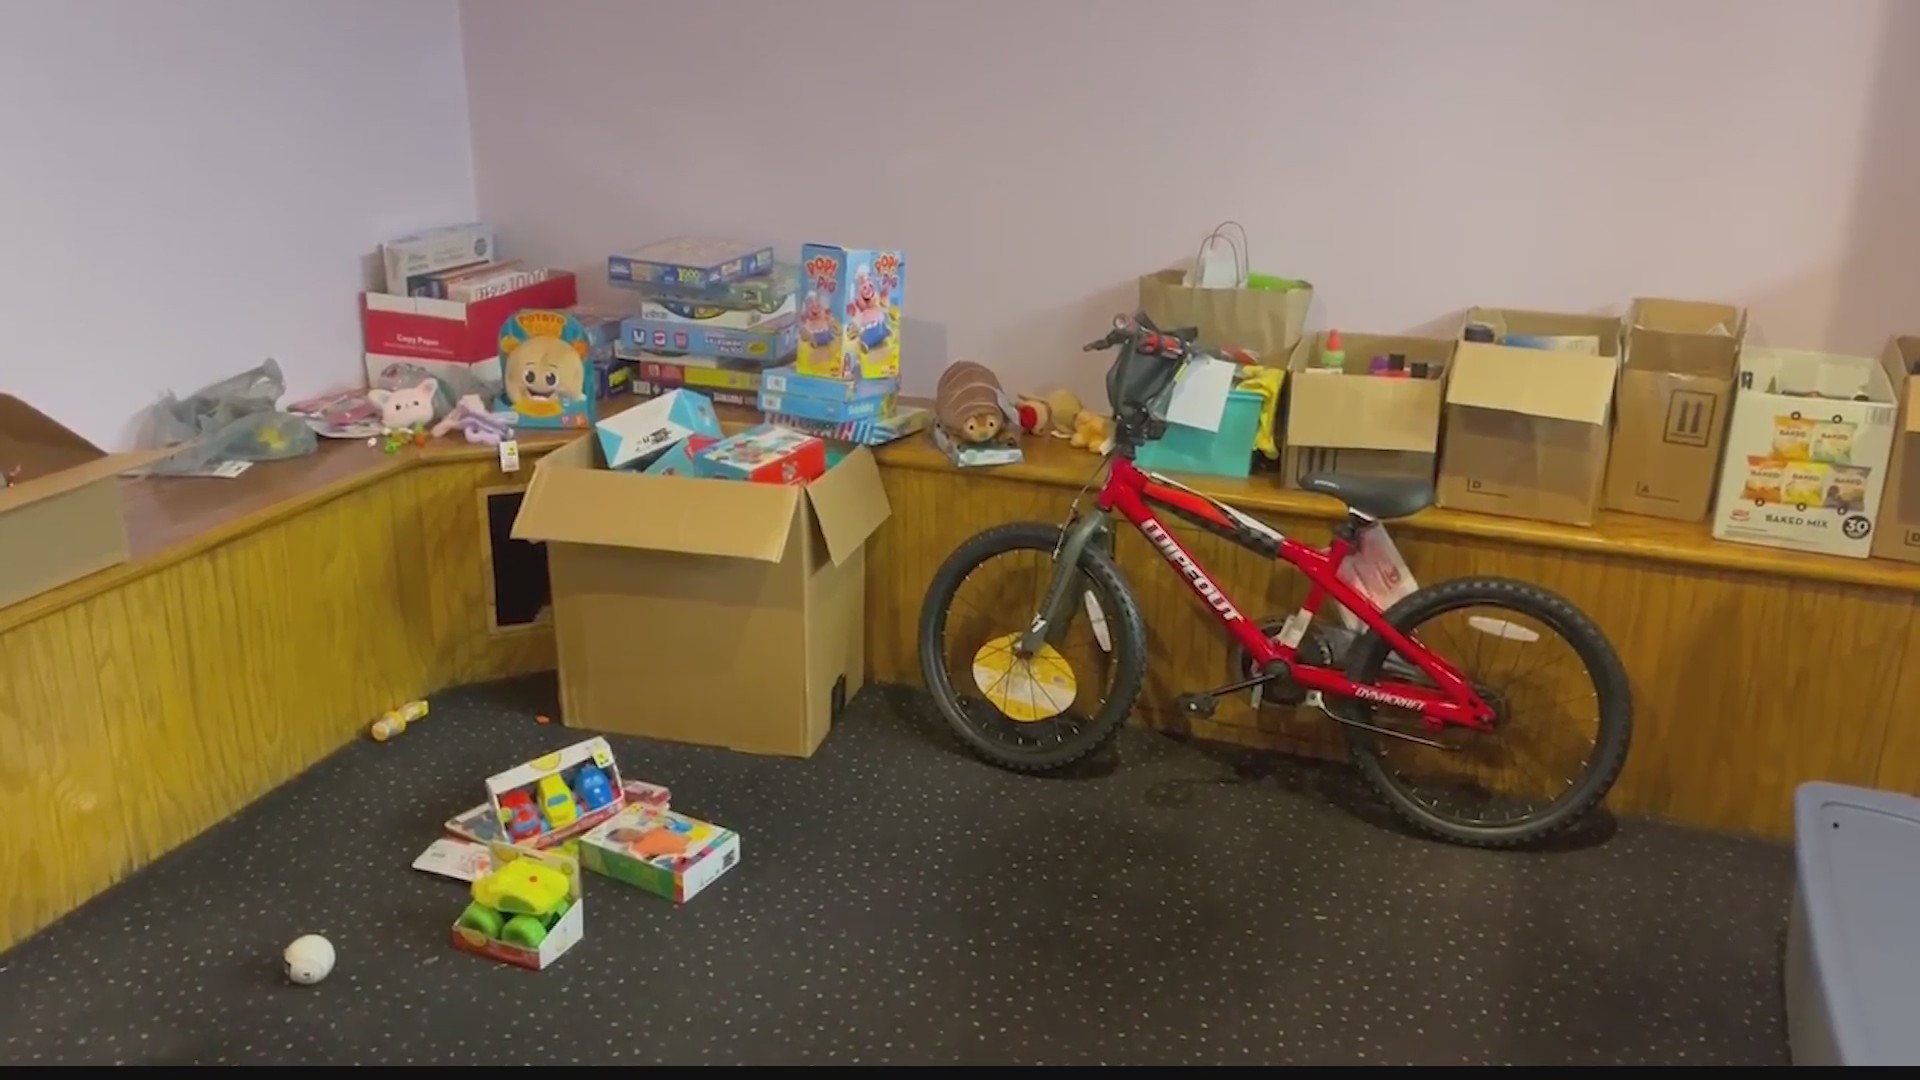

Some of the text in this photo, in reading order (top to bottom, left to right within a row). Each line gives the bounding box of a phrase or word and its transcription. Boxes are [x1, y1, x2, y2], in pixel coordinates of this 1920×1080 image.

[806, 256, 838, 276] POP!
[518, 313, 565, 324] POTATO
[396, 333, 440, 347] Copy Paper
[1779, 429, 1807, 438] BAKED
[1821, 432, 1848, 440] BAKED
[1750, 470, 1780, 478] BAKED
[1792, 473, 1820, 481] BAKED
[1472, 480, 1482, 489] D
[1765, 513, 1829, 529] BAKED MIX
[1845, 518, 1869, 535] 30
[1140, 517, 1246, 623] WIPEOUT
